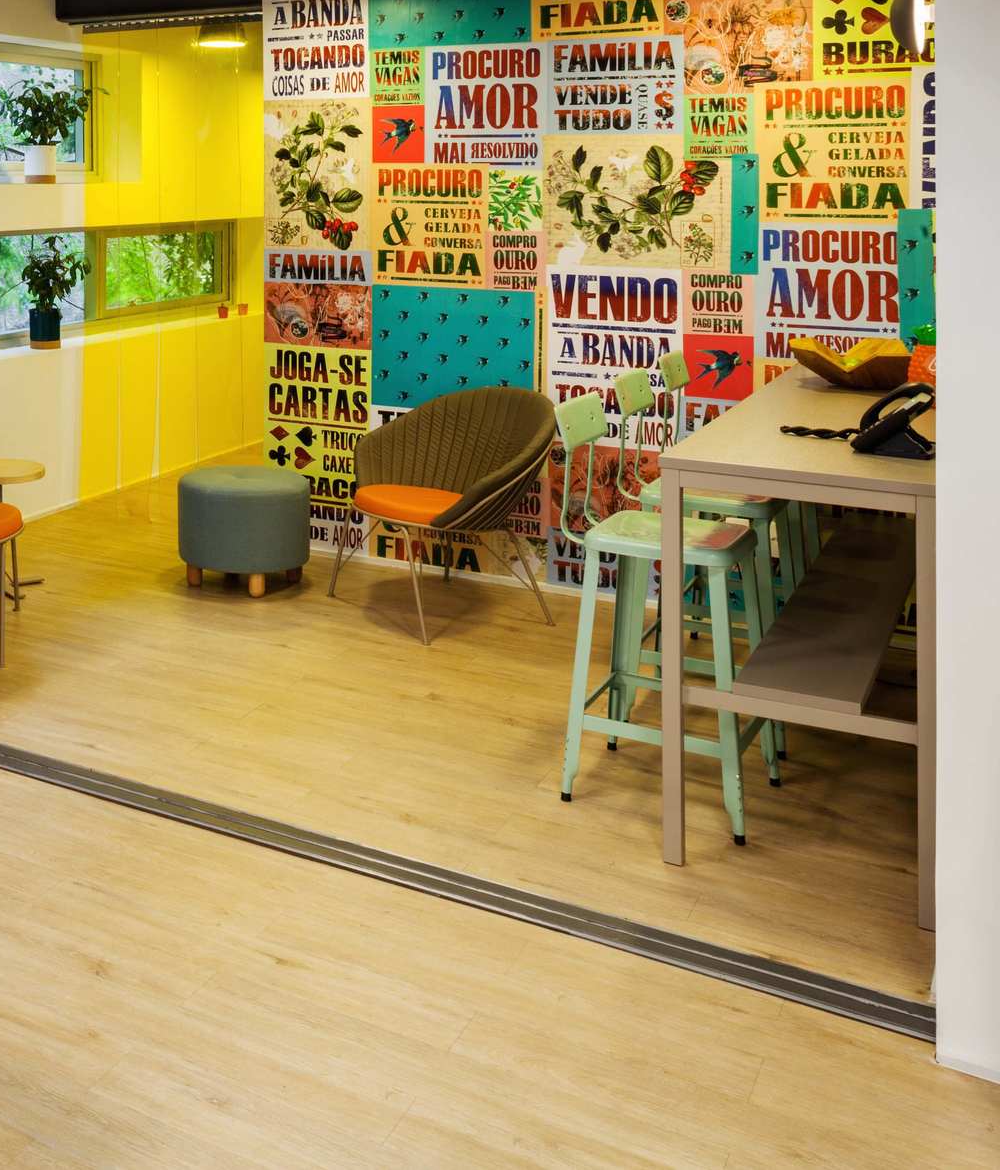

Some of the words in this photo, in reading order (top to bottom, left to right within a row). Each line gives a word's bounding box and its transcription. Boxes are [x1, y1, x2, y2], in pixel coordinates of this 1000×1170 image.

[274, 6, 287, 25] A
[327, 28, 365, 41] PASSAR
[271, 44, 365, 71] TOCANDO
[375, 50, 420, 65] TEMOS
[432, 48, 541, 80] PROCURO
[272, 75, 305, 96] COISAS
[310, 77, 330, 91] DE
[334, 71, 365, 93] AMOR
[375, 66, 420, 86] VAGAS
[553, 82, 632, 106] VENDE
[689, 96, 747, 113] TEMOS
[765, 84, 905, 120] PROCURO
[435, 83, 539, 129] AMOR
[635, 83, 648, 130] QUASE
[554, 108, 632, 131] TUDO
[690, 115, 748, 137] VAGAS
[828, 131, 905, 144] CERVEJA
[434, 144, 468, 164] MAL
[471, 141, 538, 160] RESOLVIDO
[772, 132, 816, 178] &
[828, 147, 905, 161] GELADA
[828, 165, 908, 178] CONVERSA
[378, 168, 482, 198] PROCURO
[766, 182, 906, 209] FIADA
[424, 207, 481, 220] CERVEJA
[383, 206, 416, 246] &
[424, 222, 481, 234] GELADA
[424, 236, 483, 249] CONVERSA
[493, 235, 537, 248] COMPRO
[763, 230, 898, 264] PROCURO
[378, 250, 482, 277] FIADA
[493, 250, 537, 271] OURO
[493, 275, 511, 286] PAGO
[512, 276, 537, 290] BEM
[691, 274, 742, 289] COMPRO
[551, 273, 678, 324] VENDO
[692, 290, 743, 312] OURO
[766, 268, 899, 323] AMOR
[692, 317, 711, 329] PAGO
[713, 318, 743, 334] BEM
[560, 337, 576, 358] A
[270, 349, 367, 386] JOGA-SE
[269, 383, 367, 423] CARTAS
[321, 430, 363, 451] TRUC
